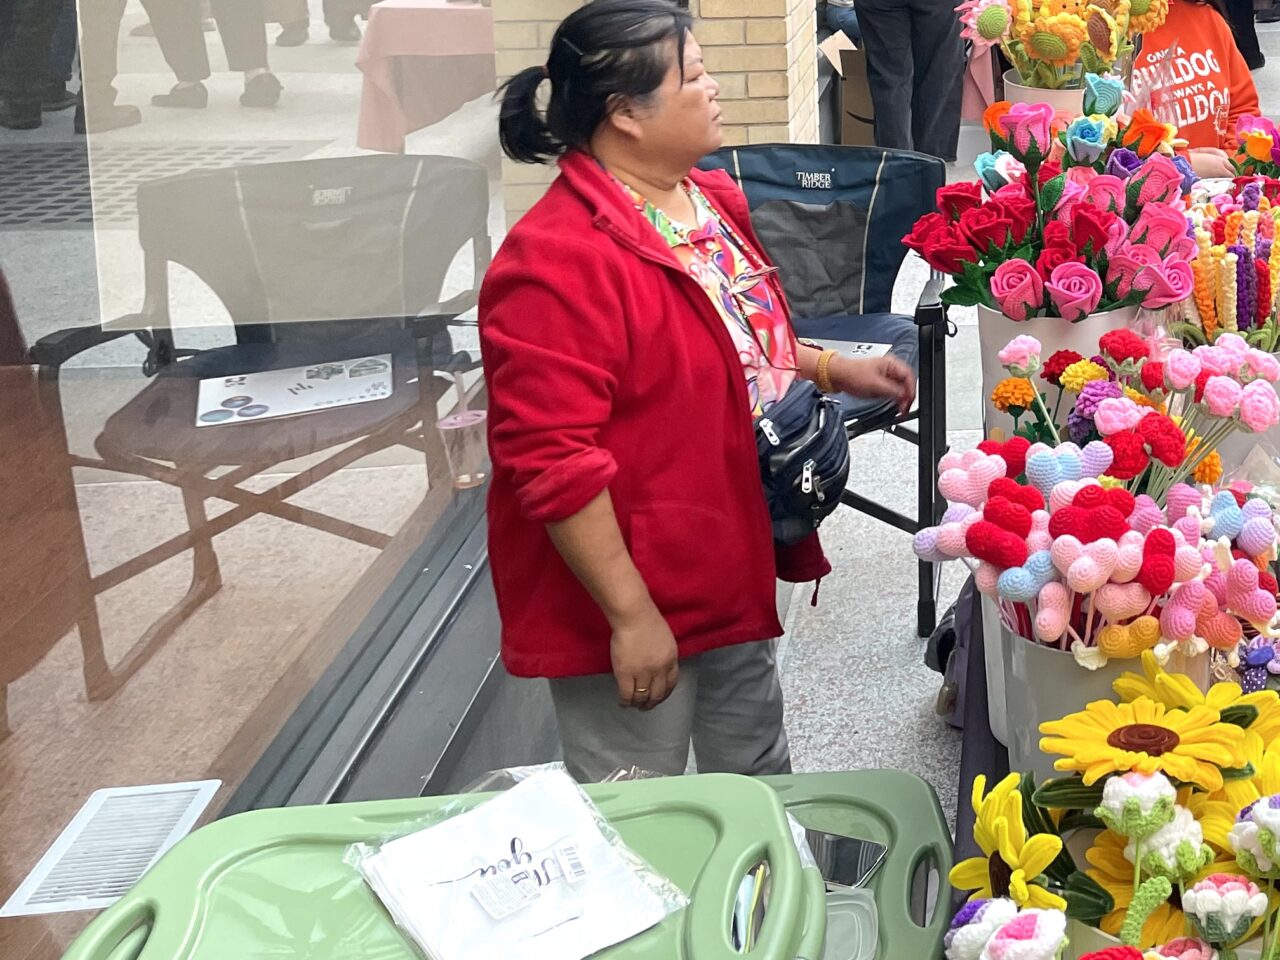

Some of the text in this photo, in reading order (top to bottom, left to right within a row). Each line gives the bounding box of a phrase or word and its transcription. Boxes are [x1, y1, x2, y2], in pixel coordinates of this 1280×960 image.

[1177, 46, 1186, 56] A
[1207, 80, 1215, 90] A
[796, 171, 831, 182] TIMBER
[802, 180, 831, 189] RIDGE
